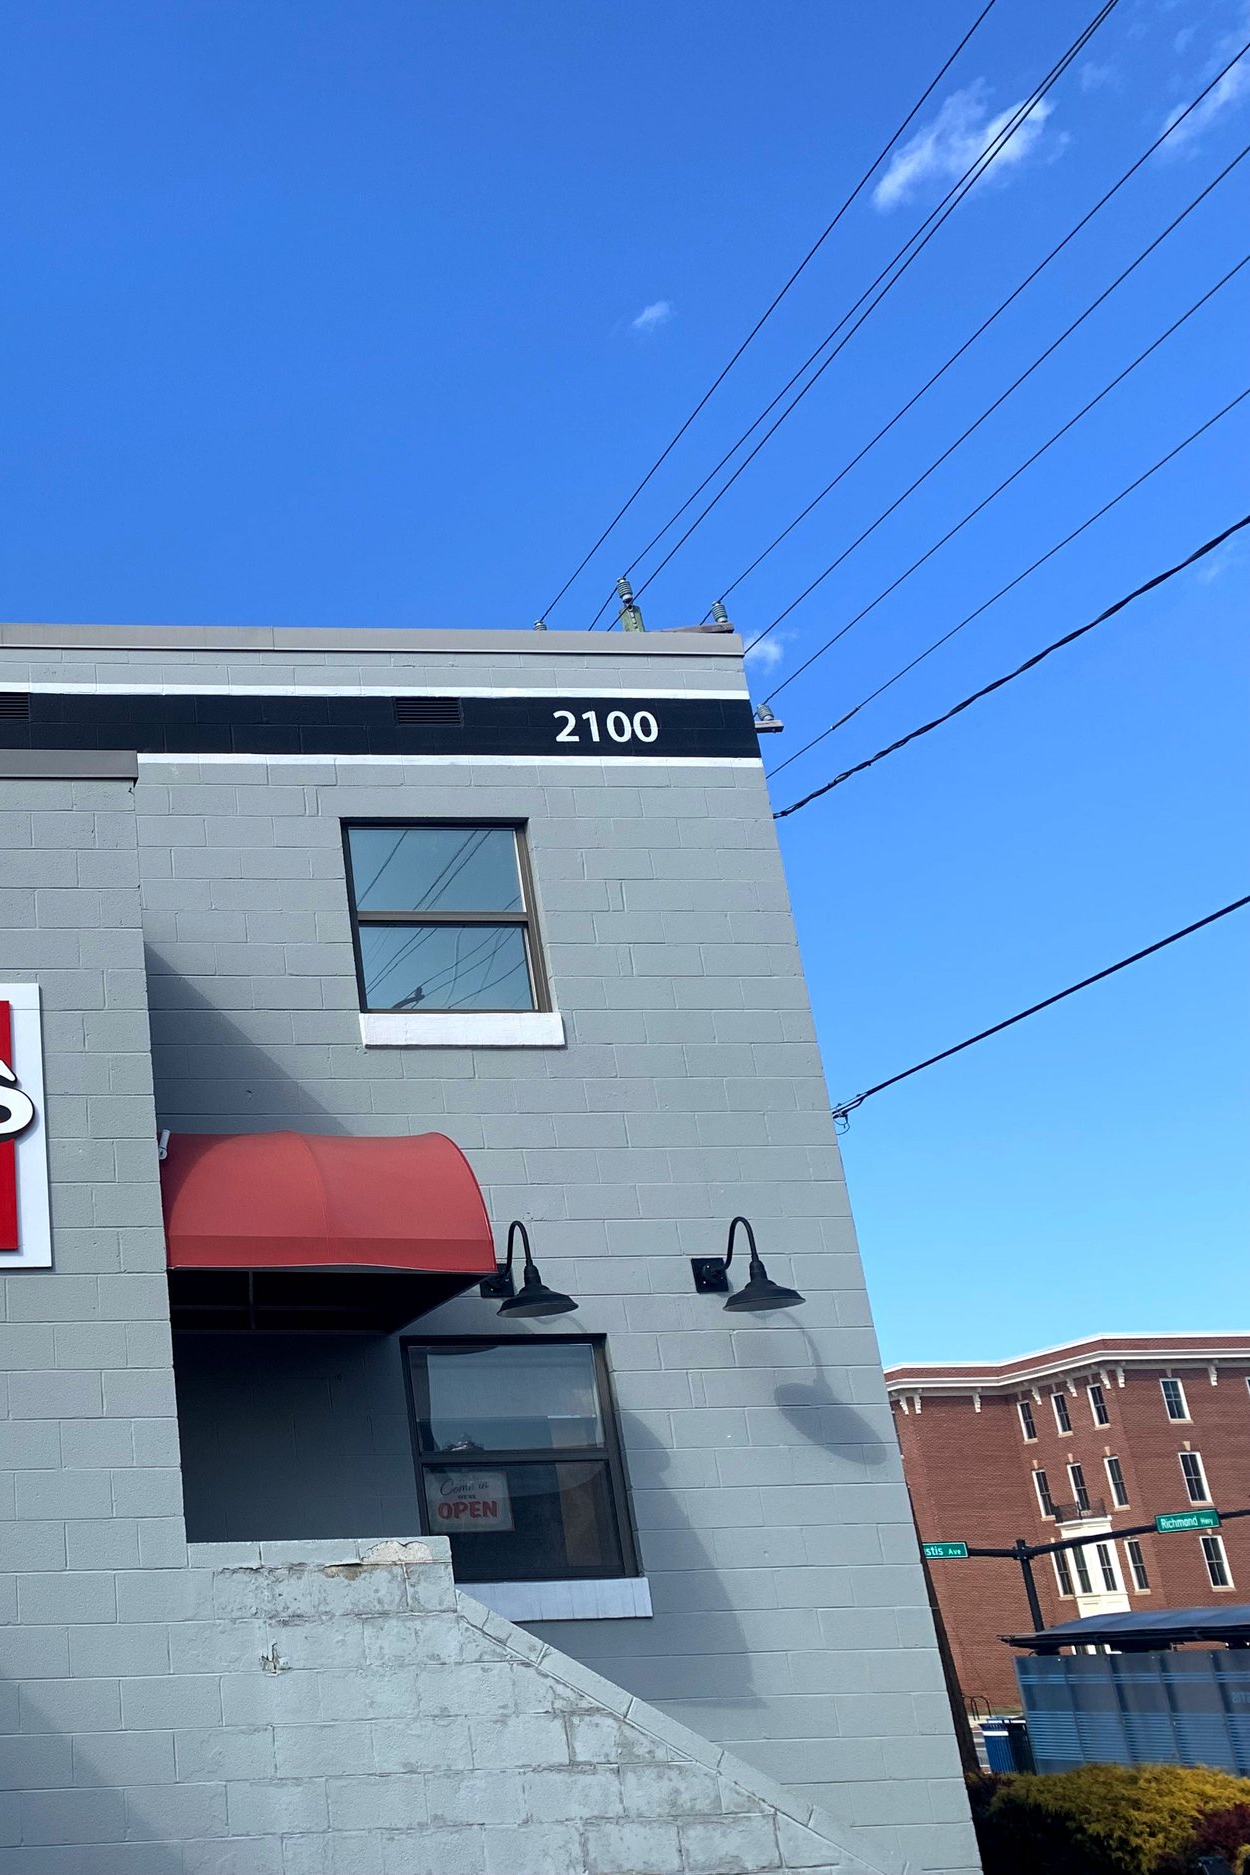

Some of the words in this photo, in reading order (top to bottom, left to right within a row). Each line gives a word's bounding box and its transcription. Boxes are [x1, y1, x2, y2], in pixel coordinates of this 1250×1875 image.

[553, 710, 659, 743] 2100
[440, 1479, 474, 1496] Come
[437, 1501, 498, 1520] OPEN
[1160, 1515, 1198, 1529] Richmond
[1200, 1517, 1214, 1526] Hwy
[924, 1545, 944, 1556] stis
